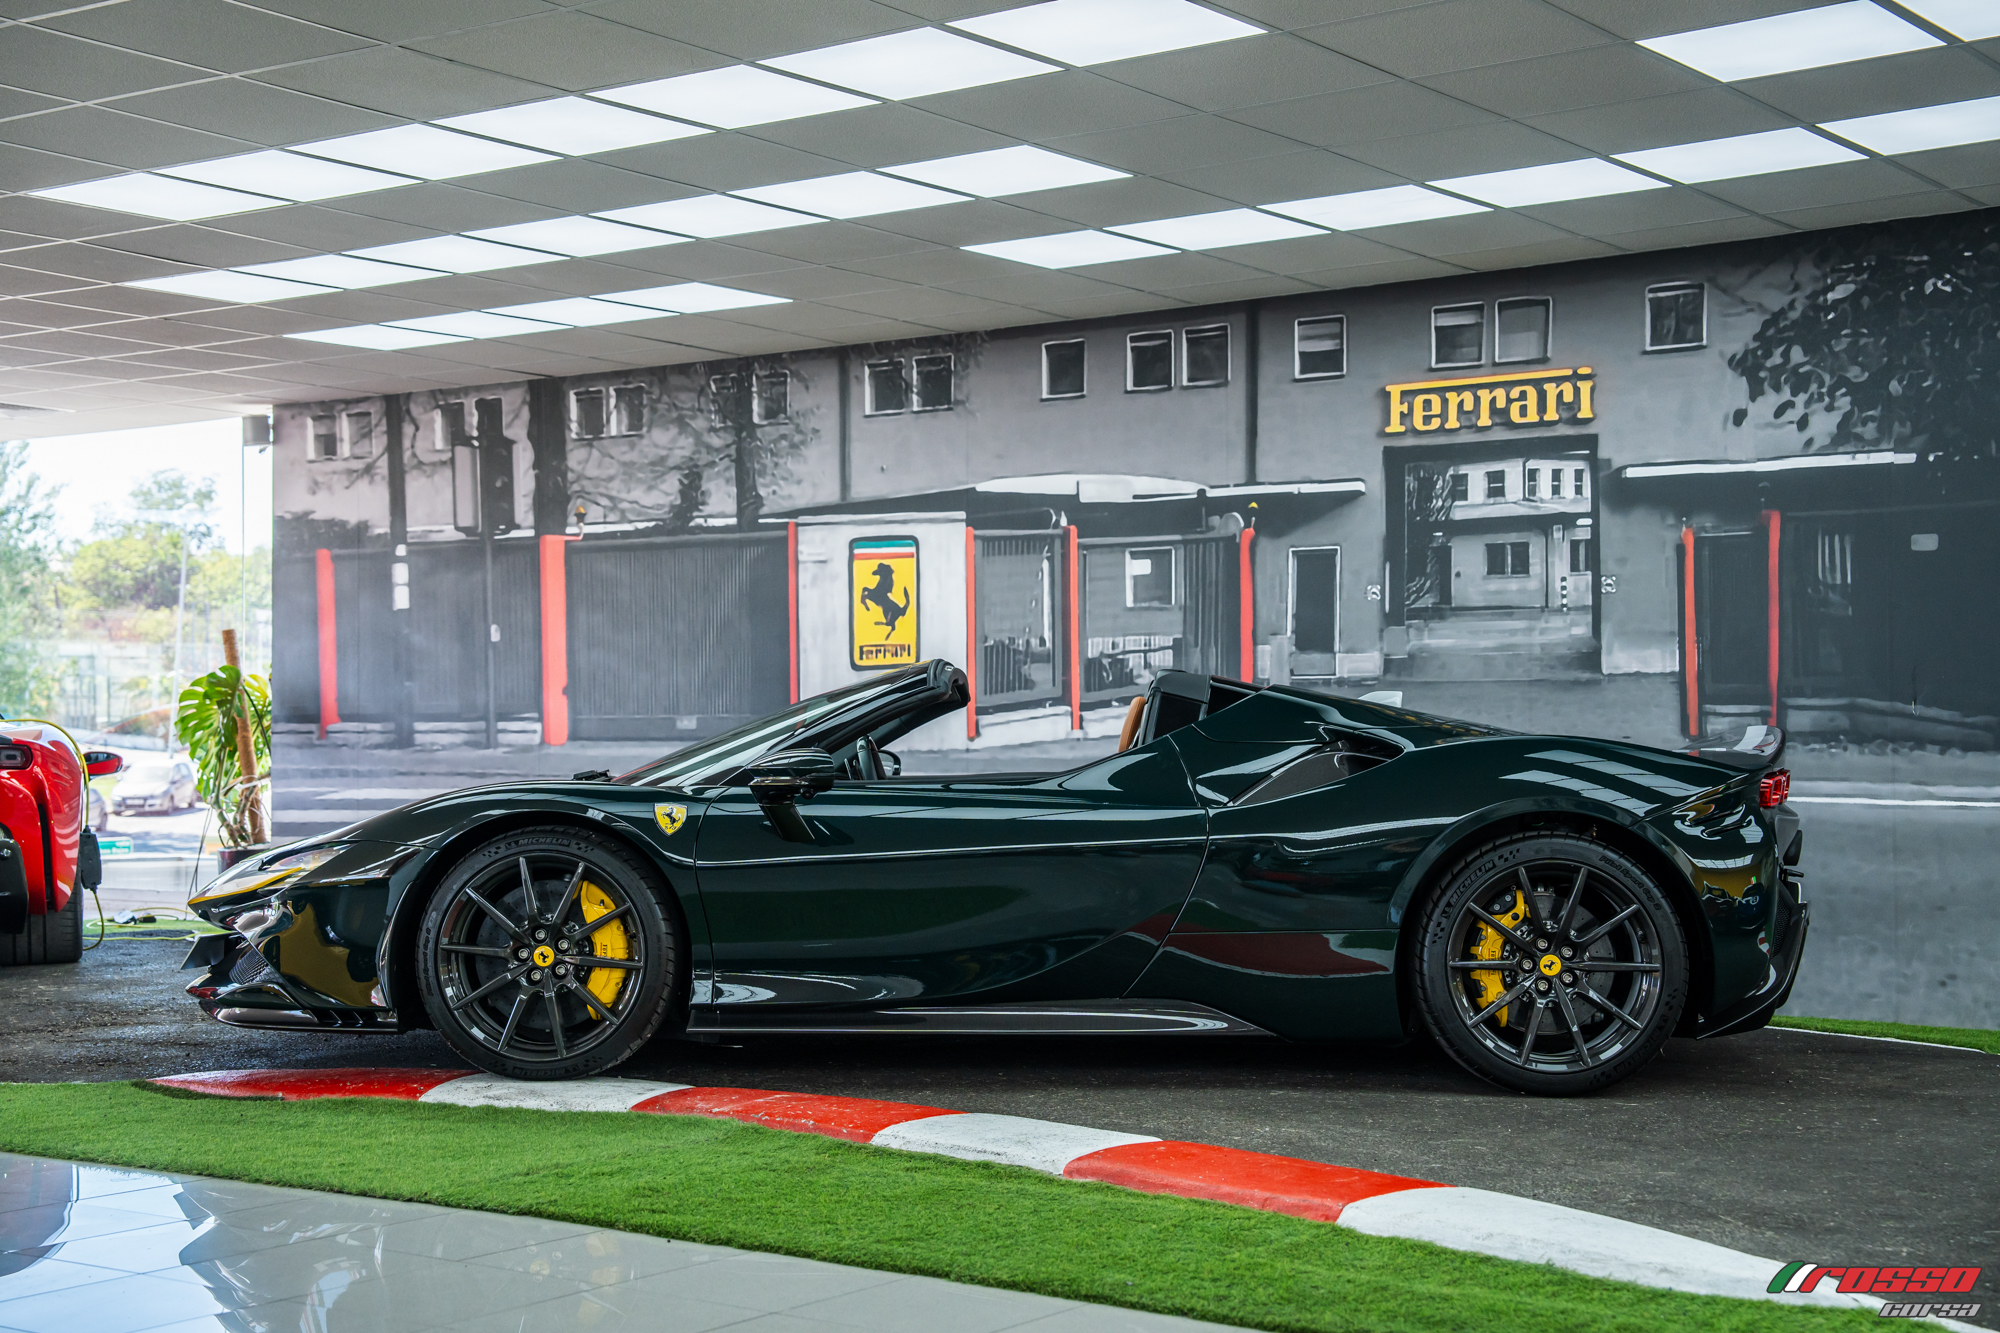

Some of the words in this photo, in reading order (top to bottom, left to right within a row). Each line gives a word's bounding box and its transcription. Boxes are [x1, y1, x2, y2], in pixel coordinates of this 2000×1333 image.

[1384, 366, 1594, 433] Ferrari
[518, 837, 571, 846] MICHELIN
[1449, 860, 1494, 906] MICHELIN
[1620, 868, 1645, 889] Sport
[512, 1066, 566, 1077] MICHELIN
